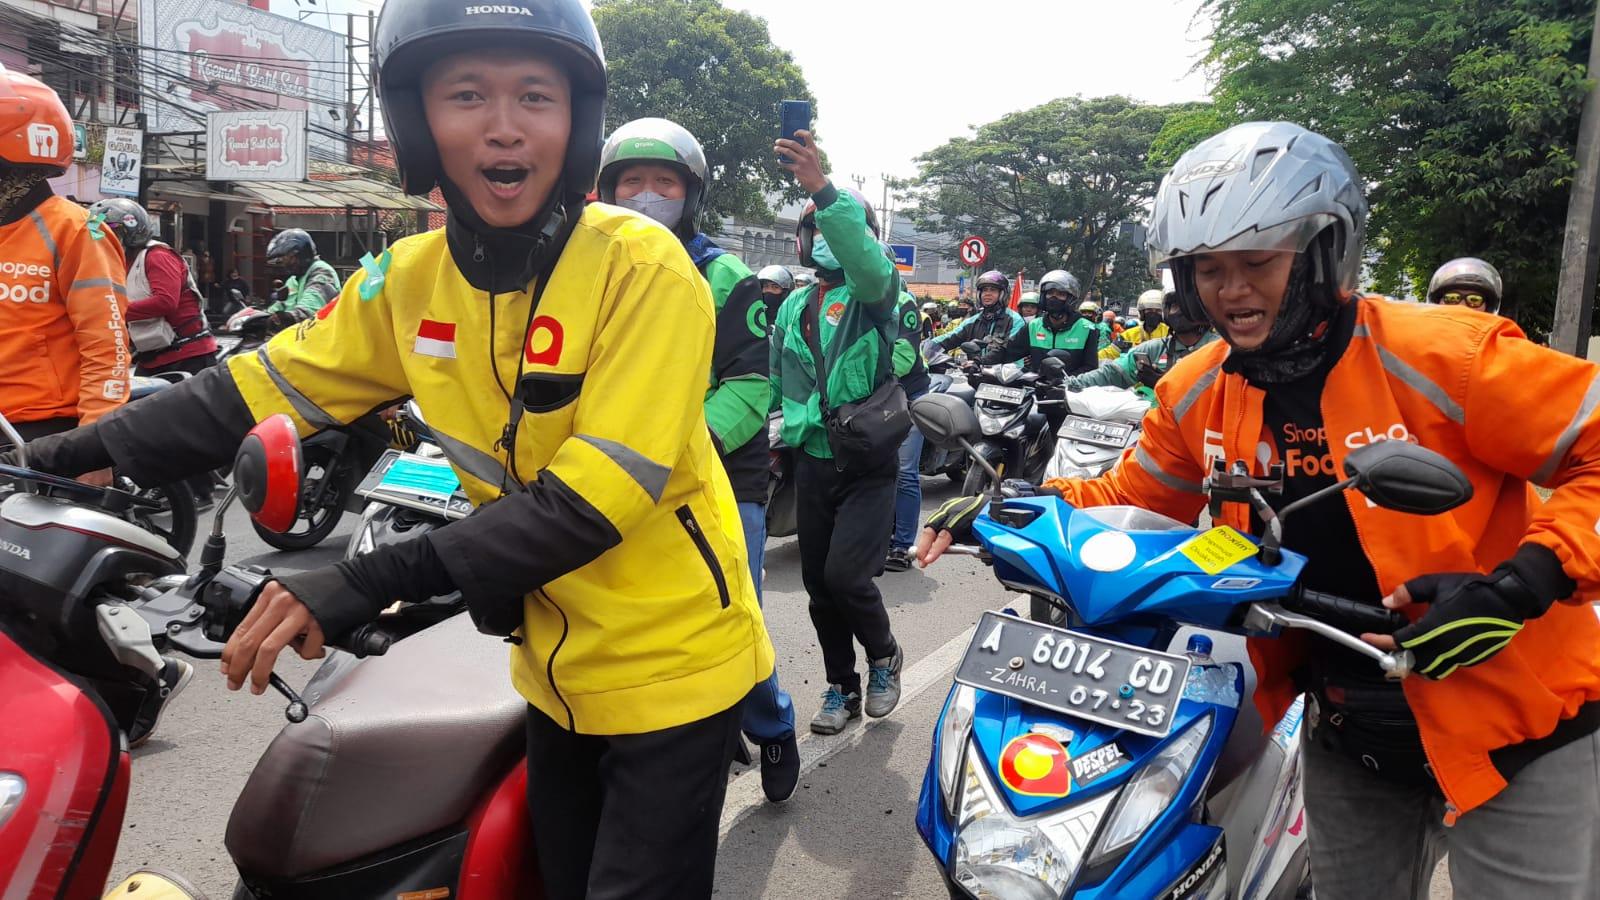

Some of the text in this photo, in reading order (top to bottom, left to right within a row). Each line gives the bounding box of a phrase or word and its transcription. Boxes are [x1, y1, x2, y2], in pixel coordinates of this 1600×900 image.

[464, 5, 534, 16] HONDA
[246, 63, 278, 89] Batik
[0, 280, 50, 303] ood
[1286, 449, 1336, 477] Foo
[0, 539, 31, 560] NDA
[981, 622, 1174, 694] A 6014 CD
[1172, 846, 1222, 900] HONDA
